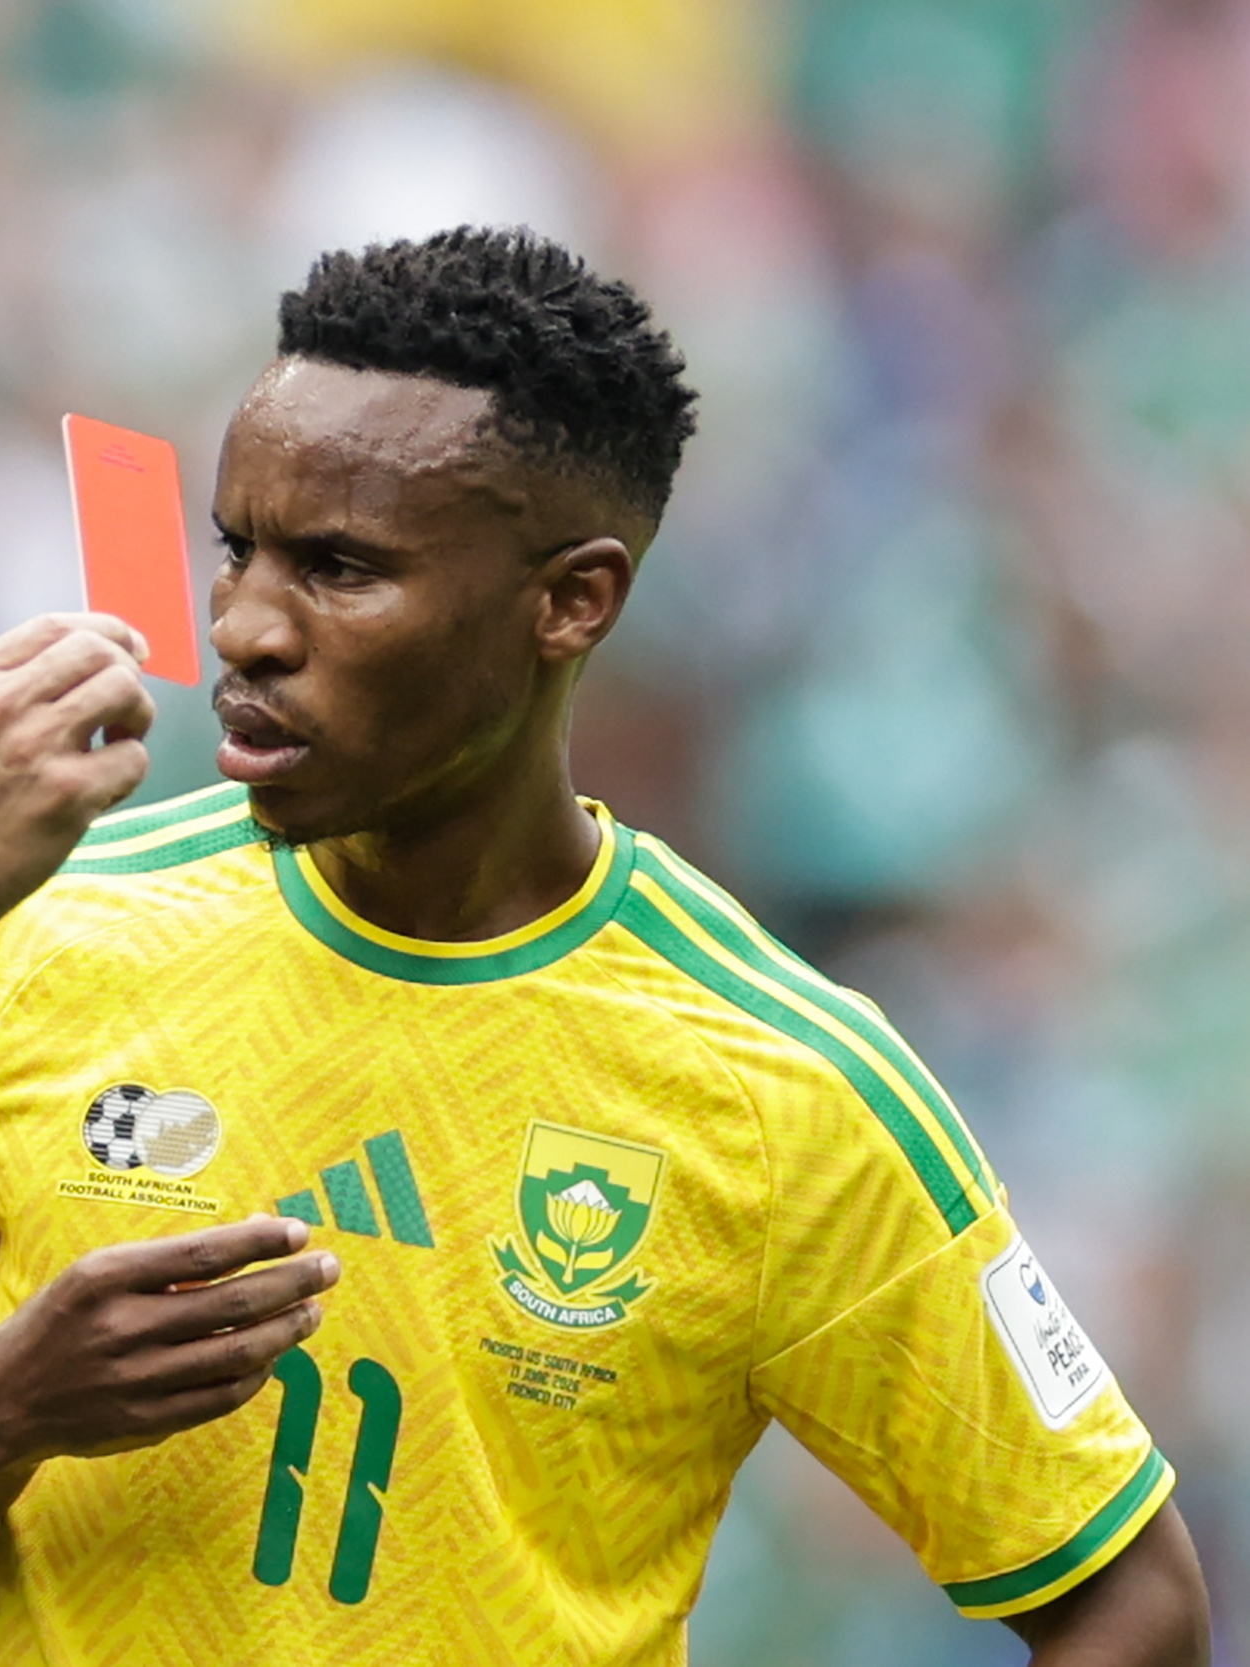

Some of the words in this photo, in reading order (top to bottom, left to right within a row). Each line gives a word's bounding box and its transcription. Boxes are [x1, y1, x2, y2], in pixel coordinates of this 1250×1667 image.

[88, 1172, 132, 1187] SOUTH
[135, 1178, 193, 1195] AFRICAN
[59, 1182, 124, 1199] FOOTBALL
[128, 1191, 218, 1212] ASSOCIATION
[508, 1280, 556, 1320] SOUTH
[558, 1306, 618, 1325] AFRICA
[544, 1354, 579, 1375] SOUTH
[1067, 1362, 1090, 1388] FIFA
[553, 1393, 578, 1412] CITY
[252, 1344, 402, 1604] 11
